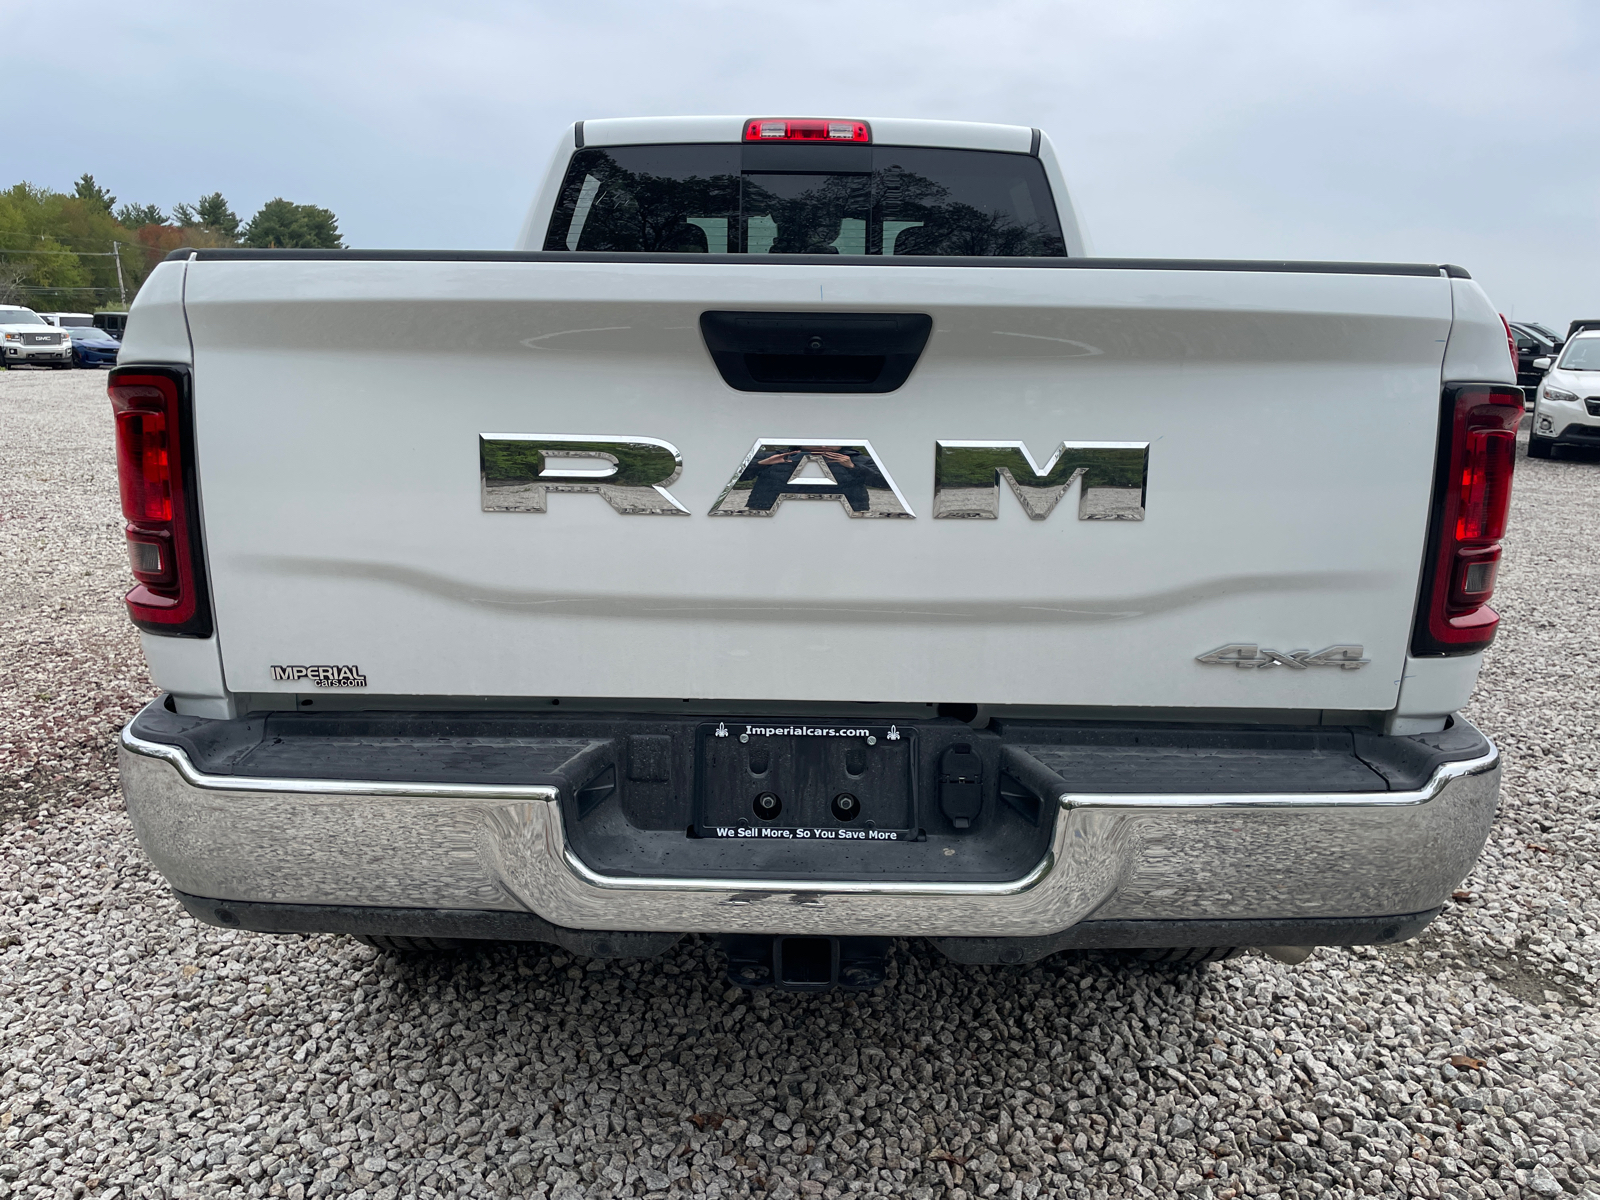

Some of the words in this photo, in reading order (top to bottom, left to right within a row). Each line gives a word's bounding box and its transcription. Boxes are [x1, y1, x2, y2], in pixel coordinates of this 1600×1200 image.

[479, 432, 1150, 521] RAM
[270, 665, 366, 680] IMPERIAL
[314, 679, 367, 687] cars.com
[745, 725, 870, 737] Imperialcars.com
[716, 827, 735, 837] We
[737, 828, 758, 837] Sell
[761, 828, 793, 839] More,
[796, 829, 811, 838] So
[814, 829, 835, 838] You
[838, 829, 866, 839] Save
[868, 830, 897, 840] More
